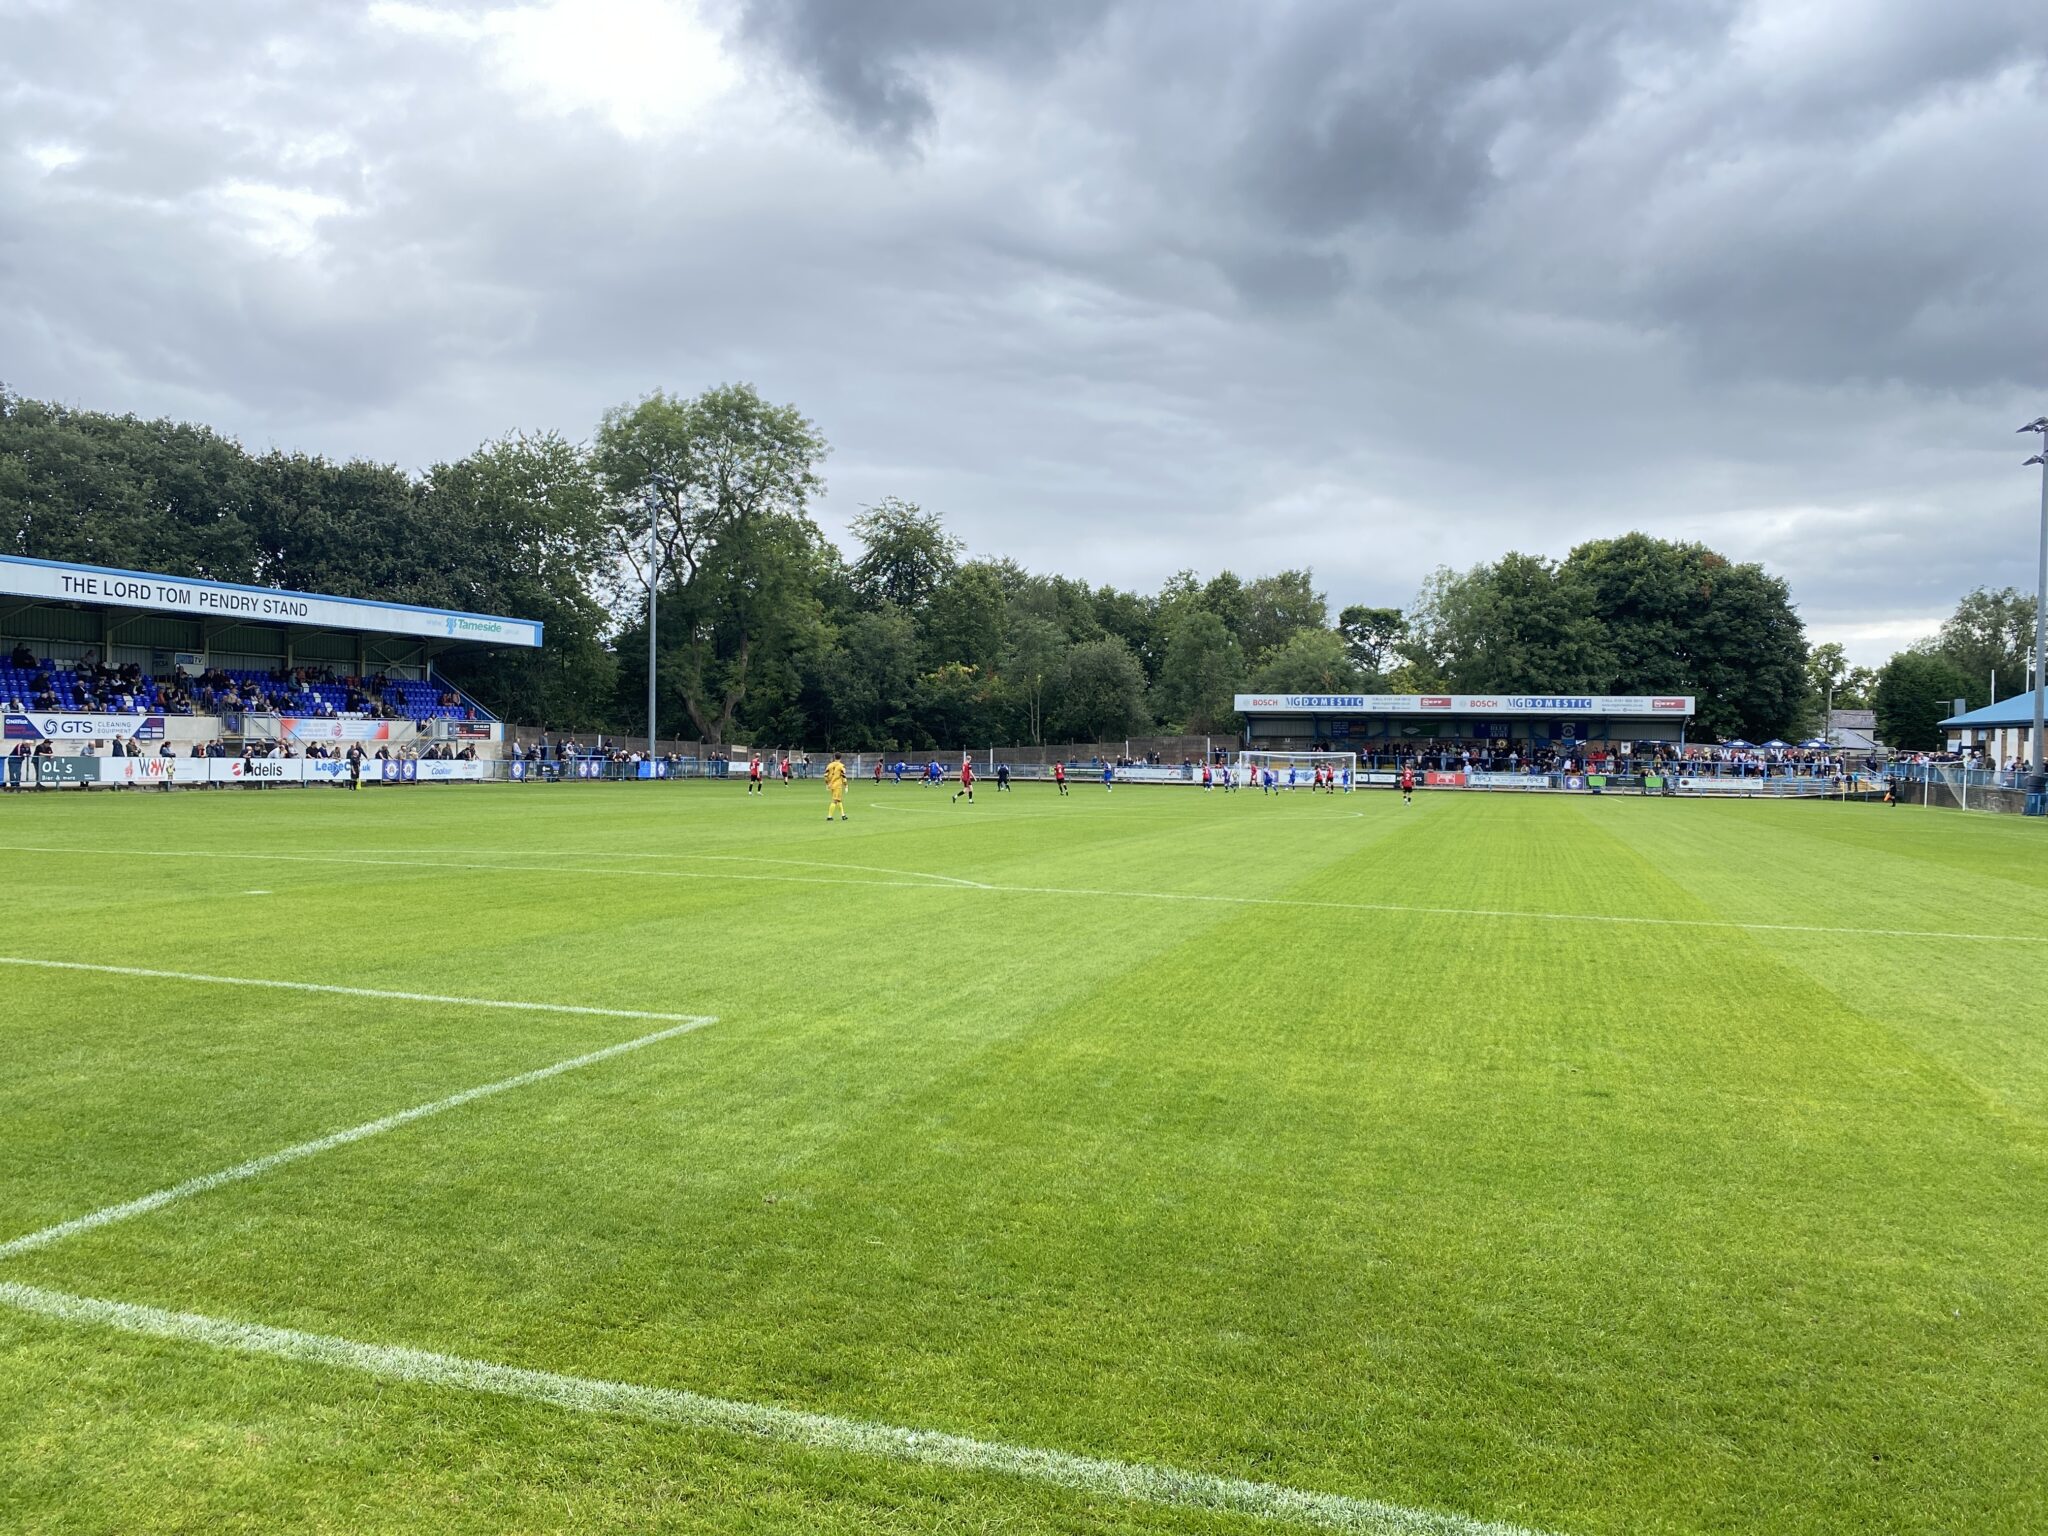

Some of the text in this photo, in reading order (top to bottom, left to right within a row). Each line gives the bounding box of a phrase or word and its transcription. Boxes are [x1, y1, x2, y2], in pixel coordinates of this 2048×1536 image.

[61, 576, 308, 617] THE LORD TOM PENDRY STAND
[458, 619, 502, 632] Tameside
[1302, 698, 1363, 706] DOMESTIC
[1470, 700, 1498, 708] BOSCH
[1525, 699, 1591, 708] DOMESTIC
[61, 721, 93, 733] GTS
[42, 758, 73, 774] OL's
